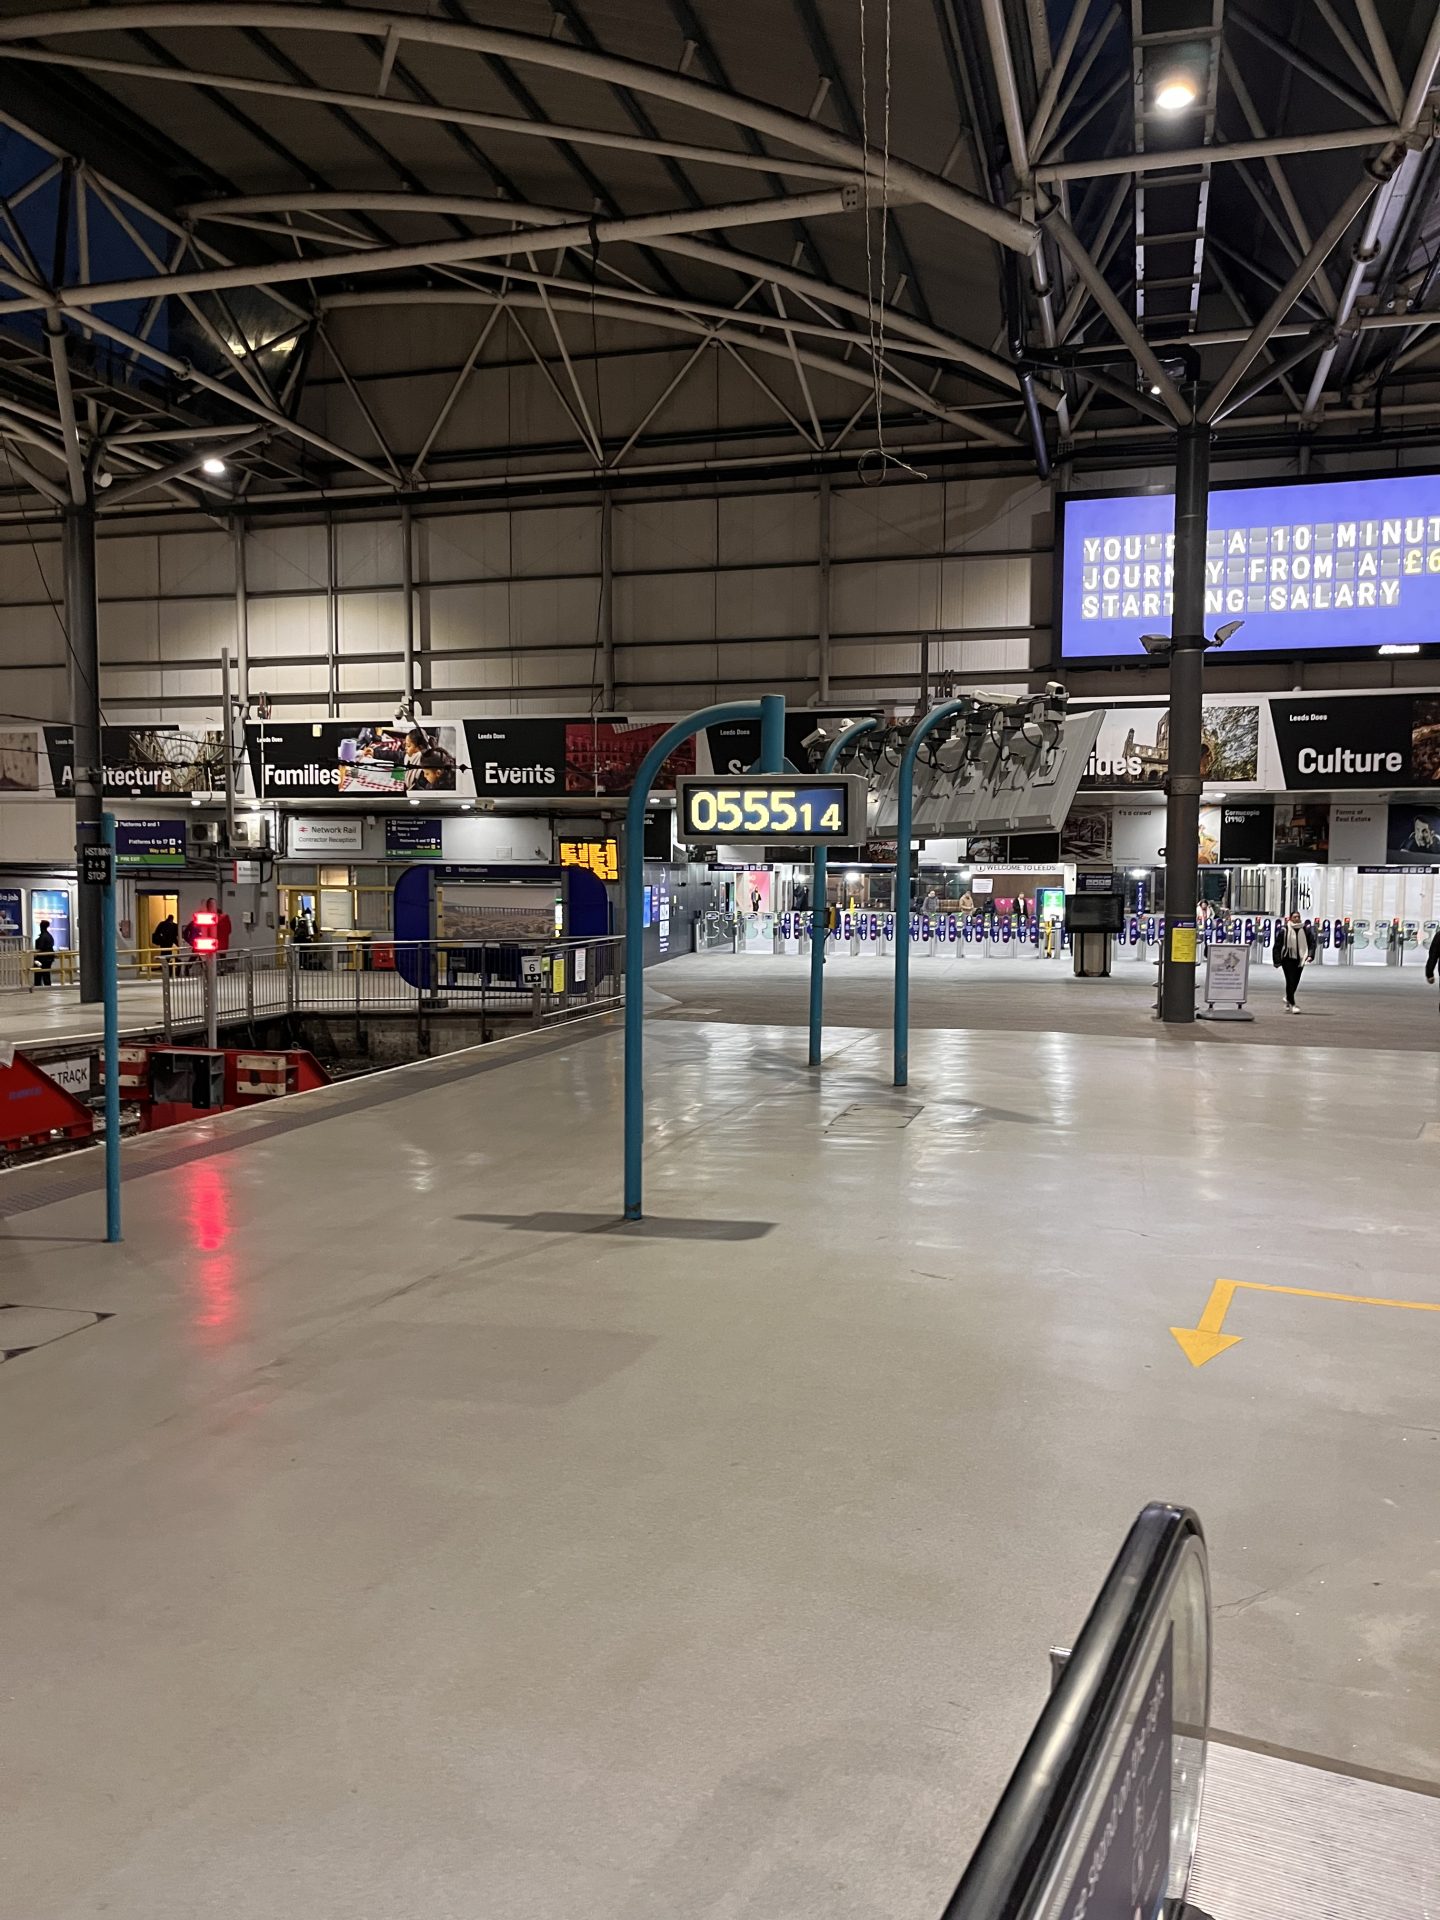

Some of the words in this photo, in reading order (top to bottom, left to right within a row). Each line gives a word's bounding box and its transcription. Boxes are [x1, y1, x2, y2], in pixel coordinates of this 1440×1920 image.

[1228, 531, 1246, 554] A
[1273, 526, 1310, 552] 10
[1083, 561, 1224, 590] JOURNY
[1250, 555, 1333, 582] FROM
[1358, 552, 1377, 577] A
[1082, 589, 1244, 618] STARTNG
[1270, 581, 1399, 610] SALARY
[1289, 714, 1309, 722] Leeds
[1311, 713, 1328, 721] Does
[1298, 747, 1403, 774] Culture
[62, 765, 172, 786] Aitecture
[264, 764, 341, 786] Families
[485, 762, 556, 784] Events
[311, 826, 341, 834] Network
[343, 826, 356, 834] Rail
[87, 871, 106, 880] STOP
[529, 963, 536, 972] 6
[58, 1067, 88, 1085] TRACK
